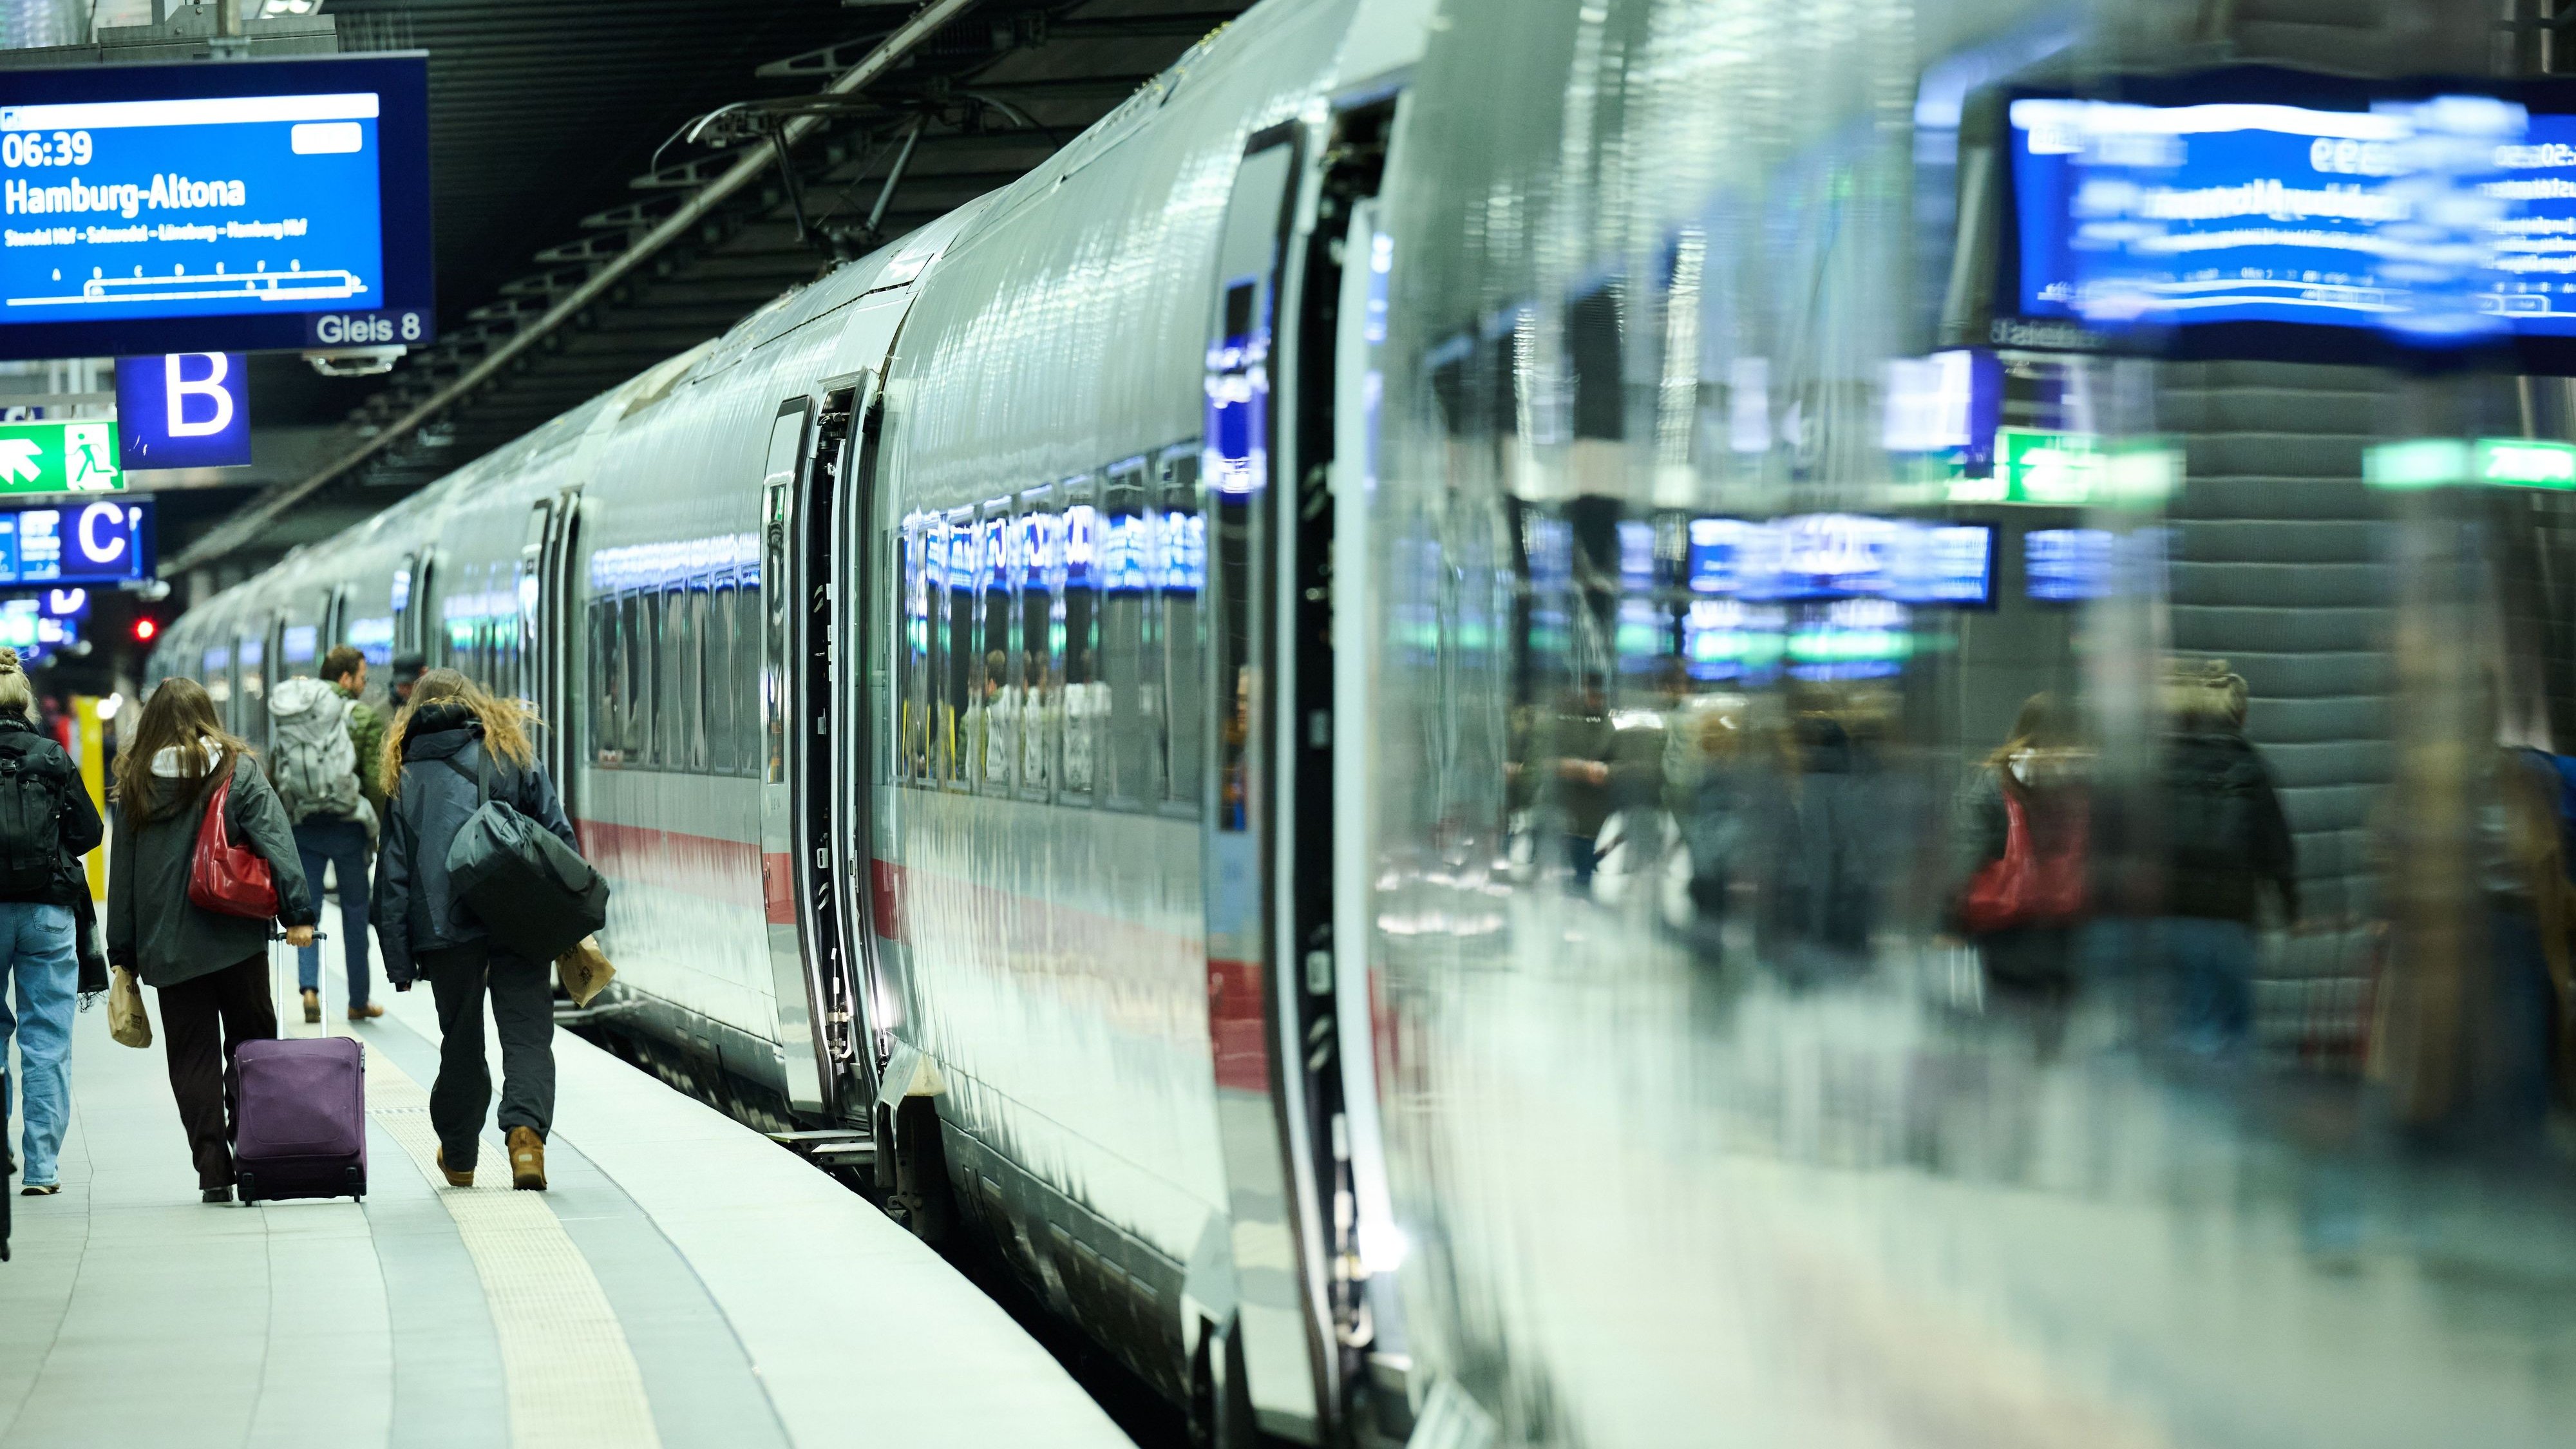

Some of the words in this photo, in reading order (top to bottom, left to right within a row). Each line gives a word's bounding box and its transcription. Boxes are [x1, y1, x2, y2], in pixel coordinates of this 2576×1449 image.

[2, 131, 93, 167] 06:39
[5, 173, 245, 218] Hamburg-Altona
[317, 314, 393, 343] Gleis
[401, 312, 421, 340] 8
[166, 352, 233, 437] B
[79, 501, 125, 562] C
